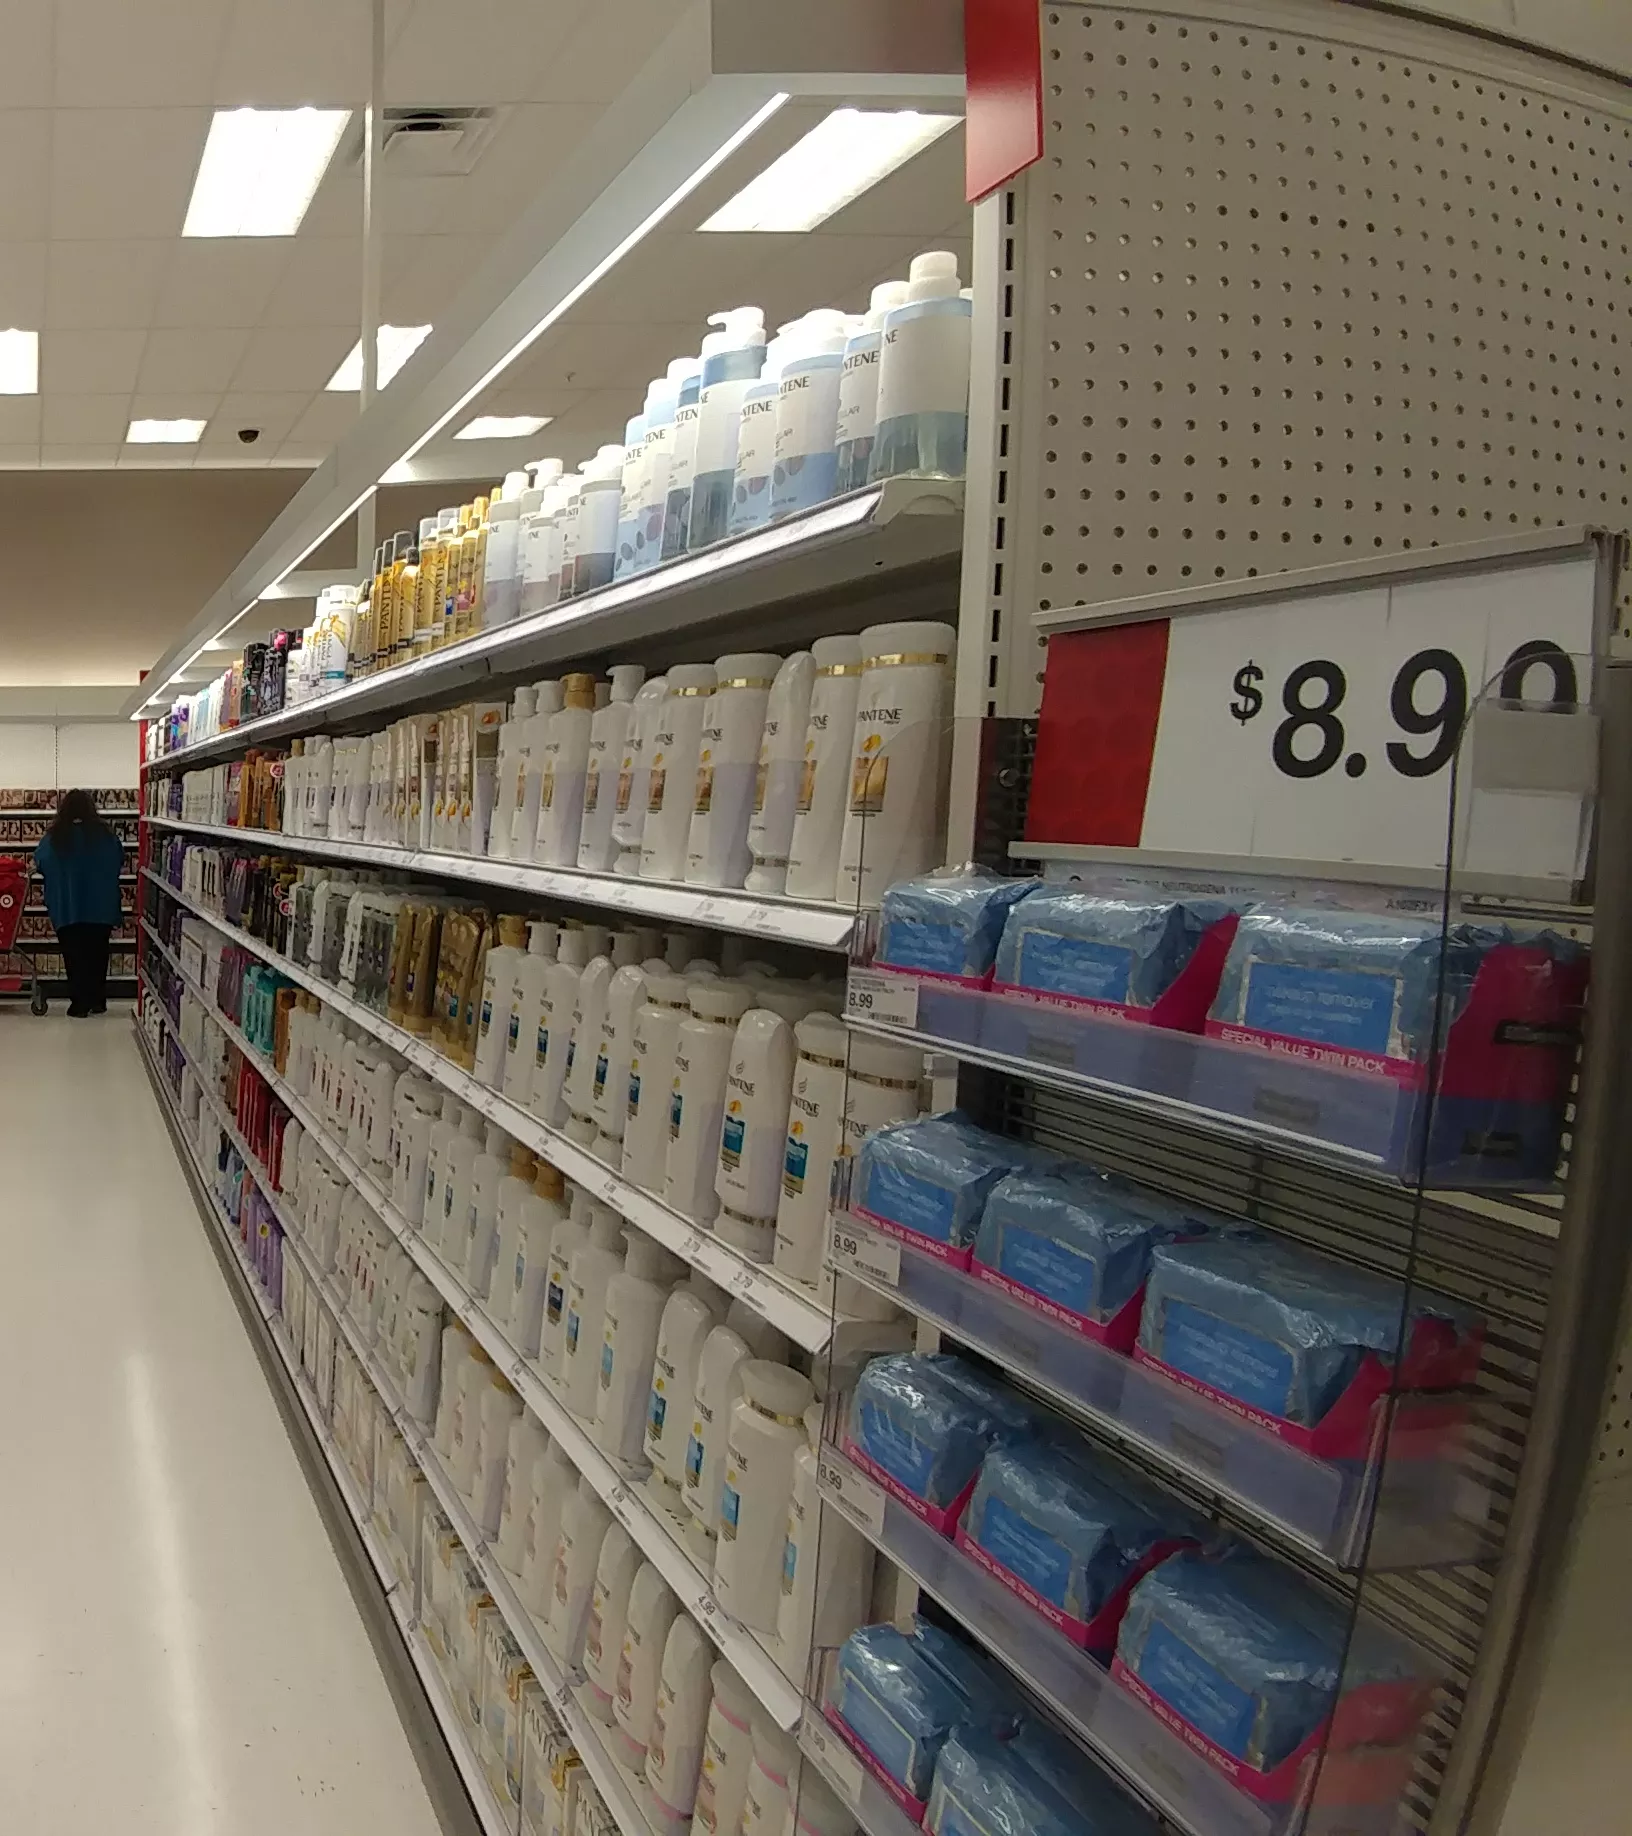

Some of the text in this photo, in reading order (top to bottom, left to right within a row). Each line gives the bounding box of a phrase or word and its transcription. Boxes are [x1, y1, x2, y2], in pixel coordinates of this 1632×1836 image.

[842, 350, 880, 371] NTENE
[780, 376, 810, 394] NTENE
[741, 400, 772, 417] NTENE
[645, 429, 666, 444] TENE
[849, 992, 873, 1008] 8.99
[1221, 1028, 1386, 1074] SPECIAL VALUE TWIN PACK
[833, 1233, 857, 1255] 8.99
[1248, 1411, 1282, 1435] PACK
[698, 1596, 716, 1616] 4.99
